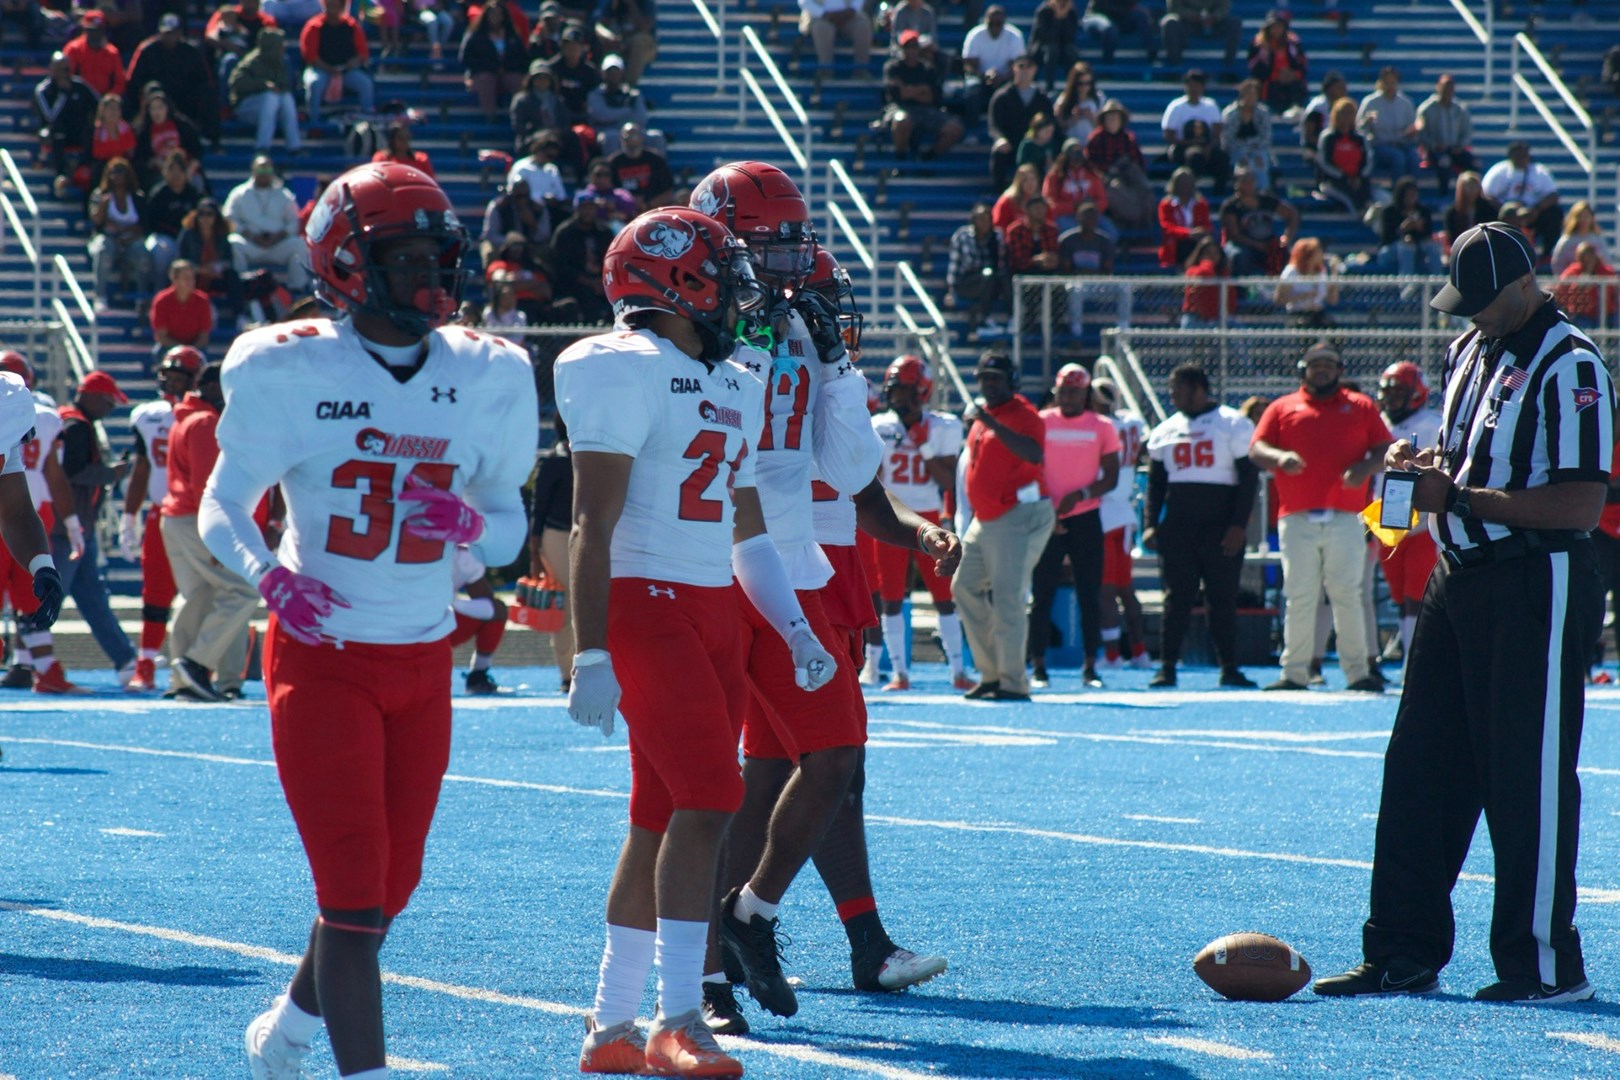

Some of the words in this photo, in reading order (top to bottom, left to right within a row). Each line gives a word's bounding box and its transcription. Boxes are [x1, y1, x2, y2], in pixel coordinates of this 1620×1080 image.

[671, 377, 703, 393] CIAA
[316, 400, 372, 420] CIAA
[1173, 440, 1214, 470] 96
[890, 452, 931, 485] 20
